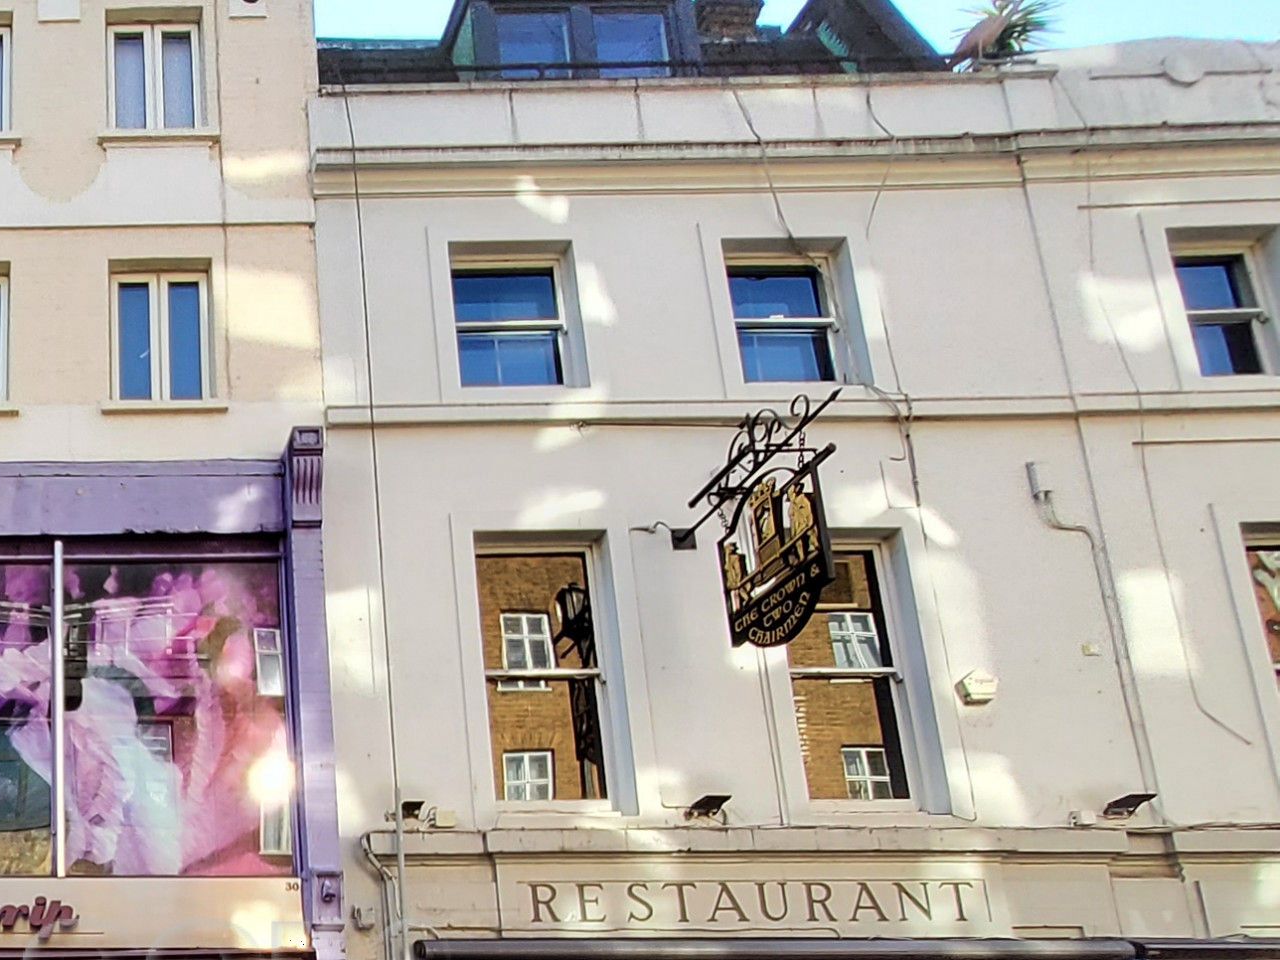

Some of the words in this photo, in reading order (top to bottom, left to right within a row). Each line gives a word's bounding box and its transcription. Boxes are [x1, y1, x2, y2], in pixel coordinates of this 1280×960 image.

[734, 606, 759, 632] THE
[761, 572, 806, 613] CROWN
[810, 563, 821, 578] &
[748, 591, 811, 644] CHAIRMEN
[763, 600, 793, 627] TWO
[285, 882, 300, 891] 30
[528, 881, 974, 923] RESTAURANT
